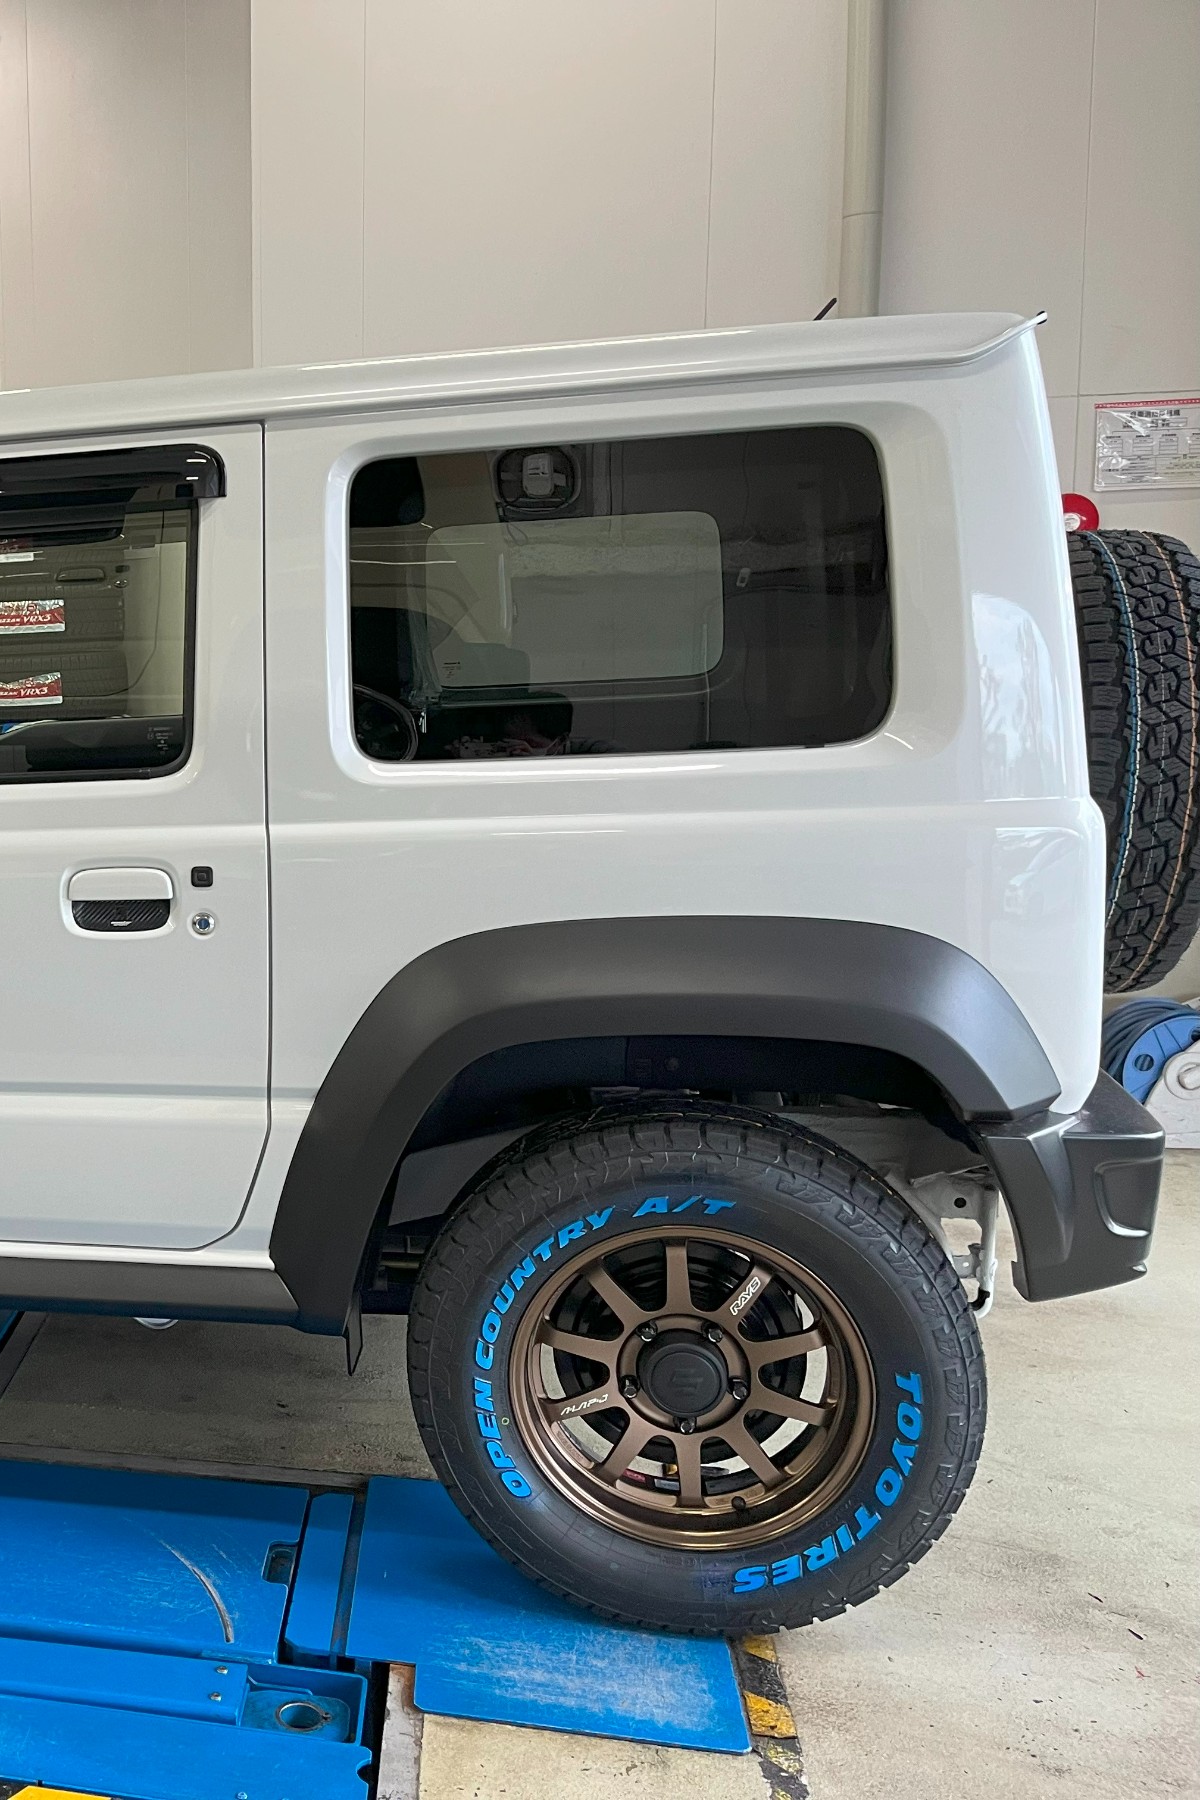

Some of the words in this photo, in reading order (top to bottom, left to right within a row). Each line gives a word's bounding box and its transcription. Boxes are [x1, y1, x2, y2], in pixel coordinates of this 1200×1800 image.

[22, 613, 52, 623] VRX3
[19, 687, 49, 697] VRX3
[632, 1195, 737, 1218] A/T
[475, 1204, 616, 1371] COUNTRY
[730, 1276, 761, 1316] RAYS
[474, 1377, 532, 1498] OPEN
[875, 1371, 924, 1507] TOYO
[733, 1504, 882, 1594] TIRES
